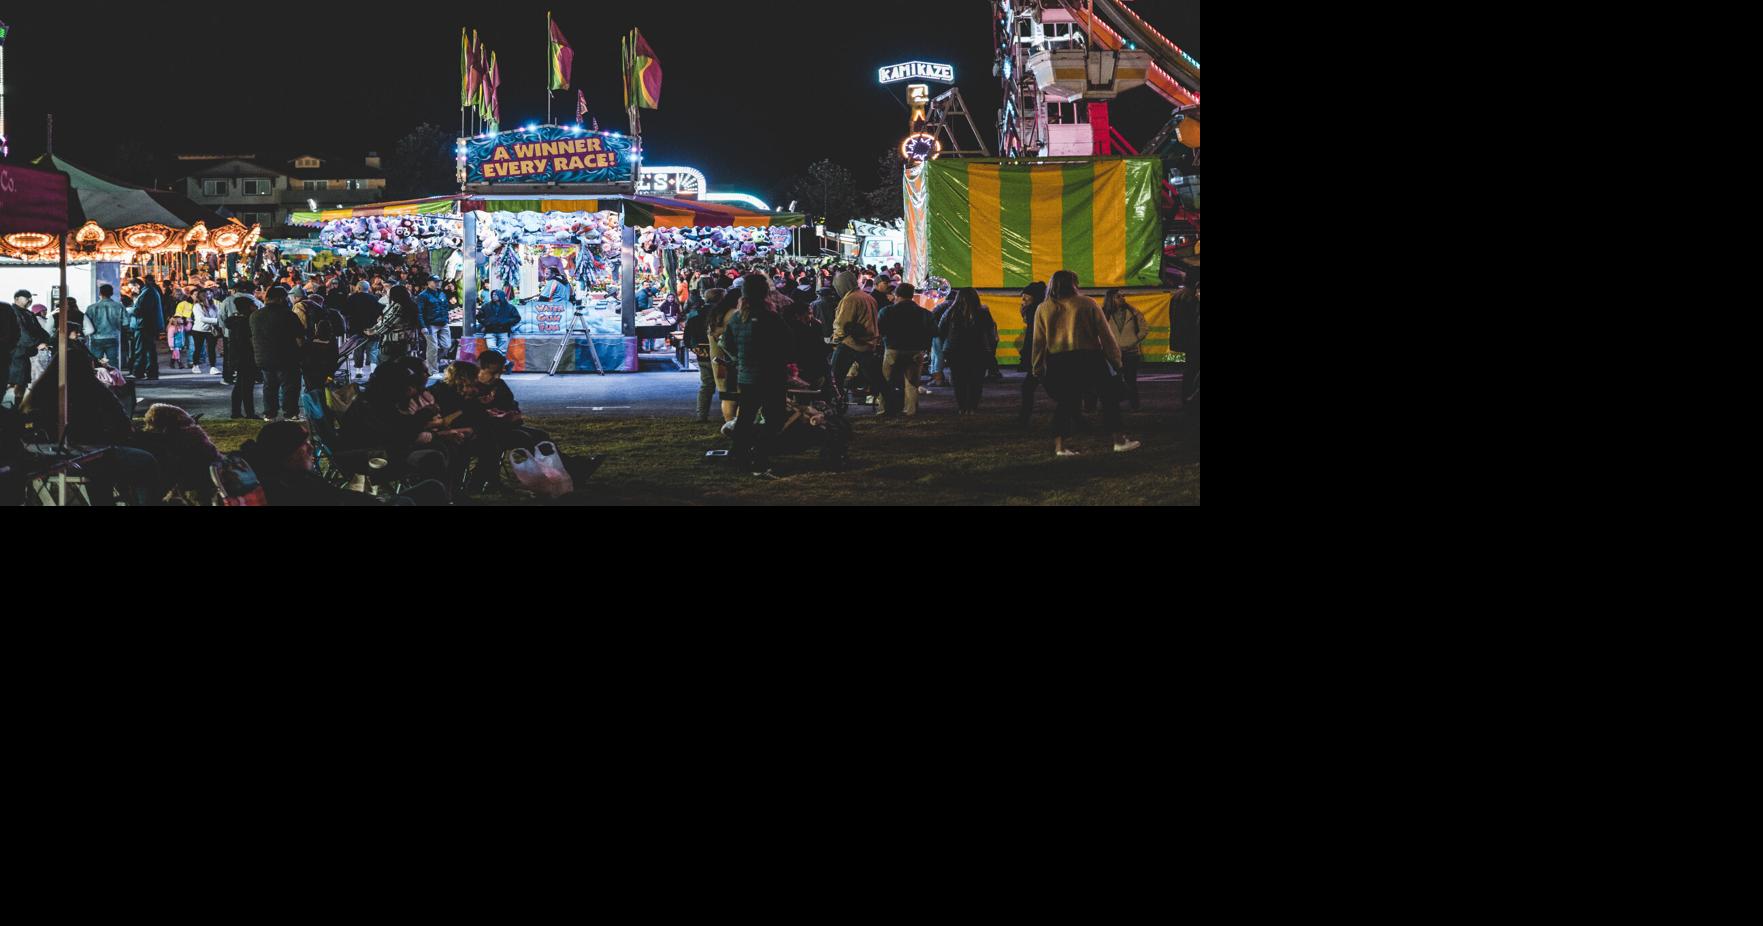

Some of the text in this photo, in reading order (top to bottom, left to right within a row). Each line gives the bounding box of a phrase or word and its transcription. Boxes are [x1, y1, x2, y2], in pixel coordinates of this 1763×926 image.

[881, 63, 951, 81] KAMIKAZE
[493, 138, 602, 161] A WINNER
[483, 152, 616, 178] EVERY RACE!
